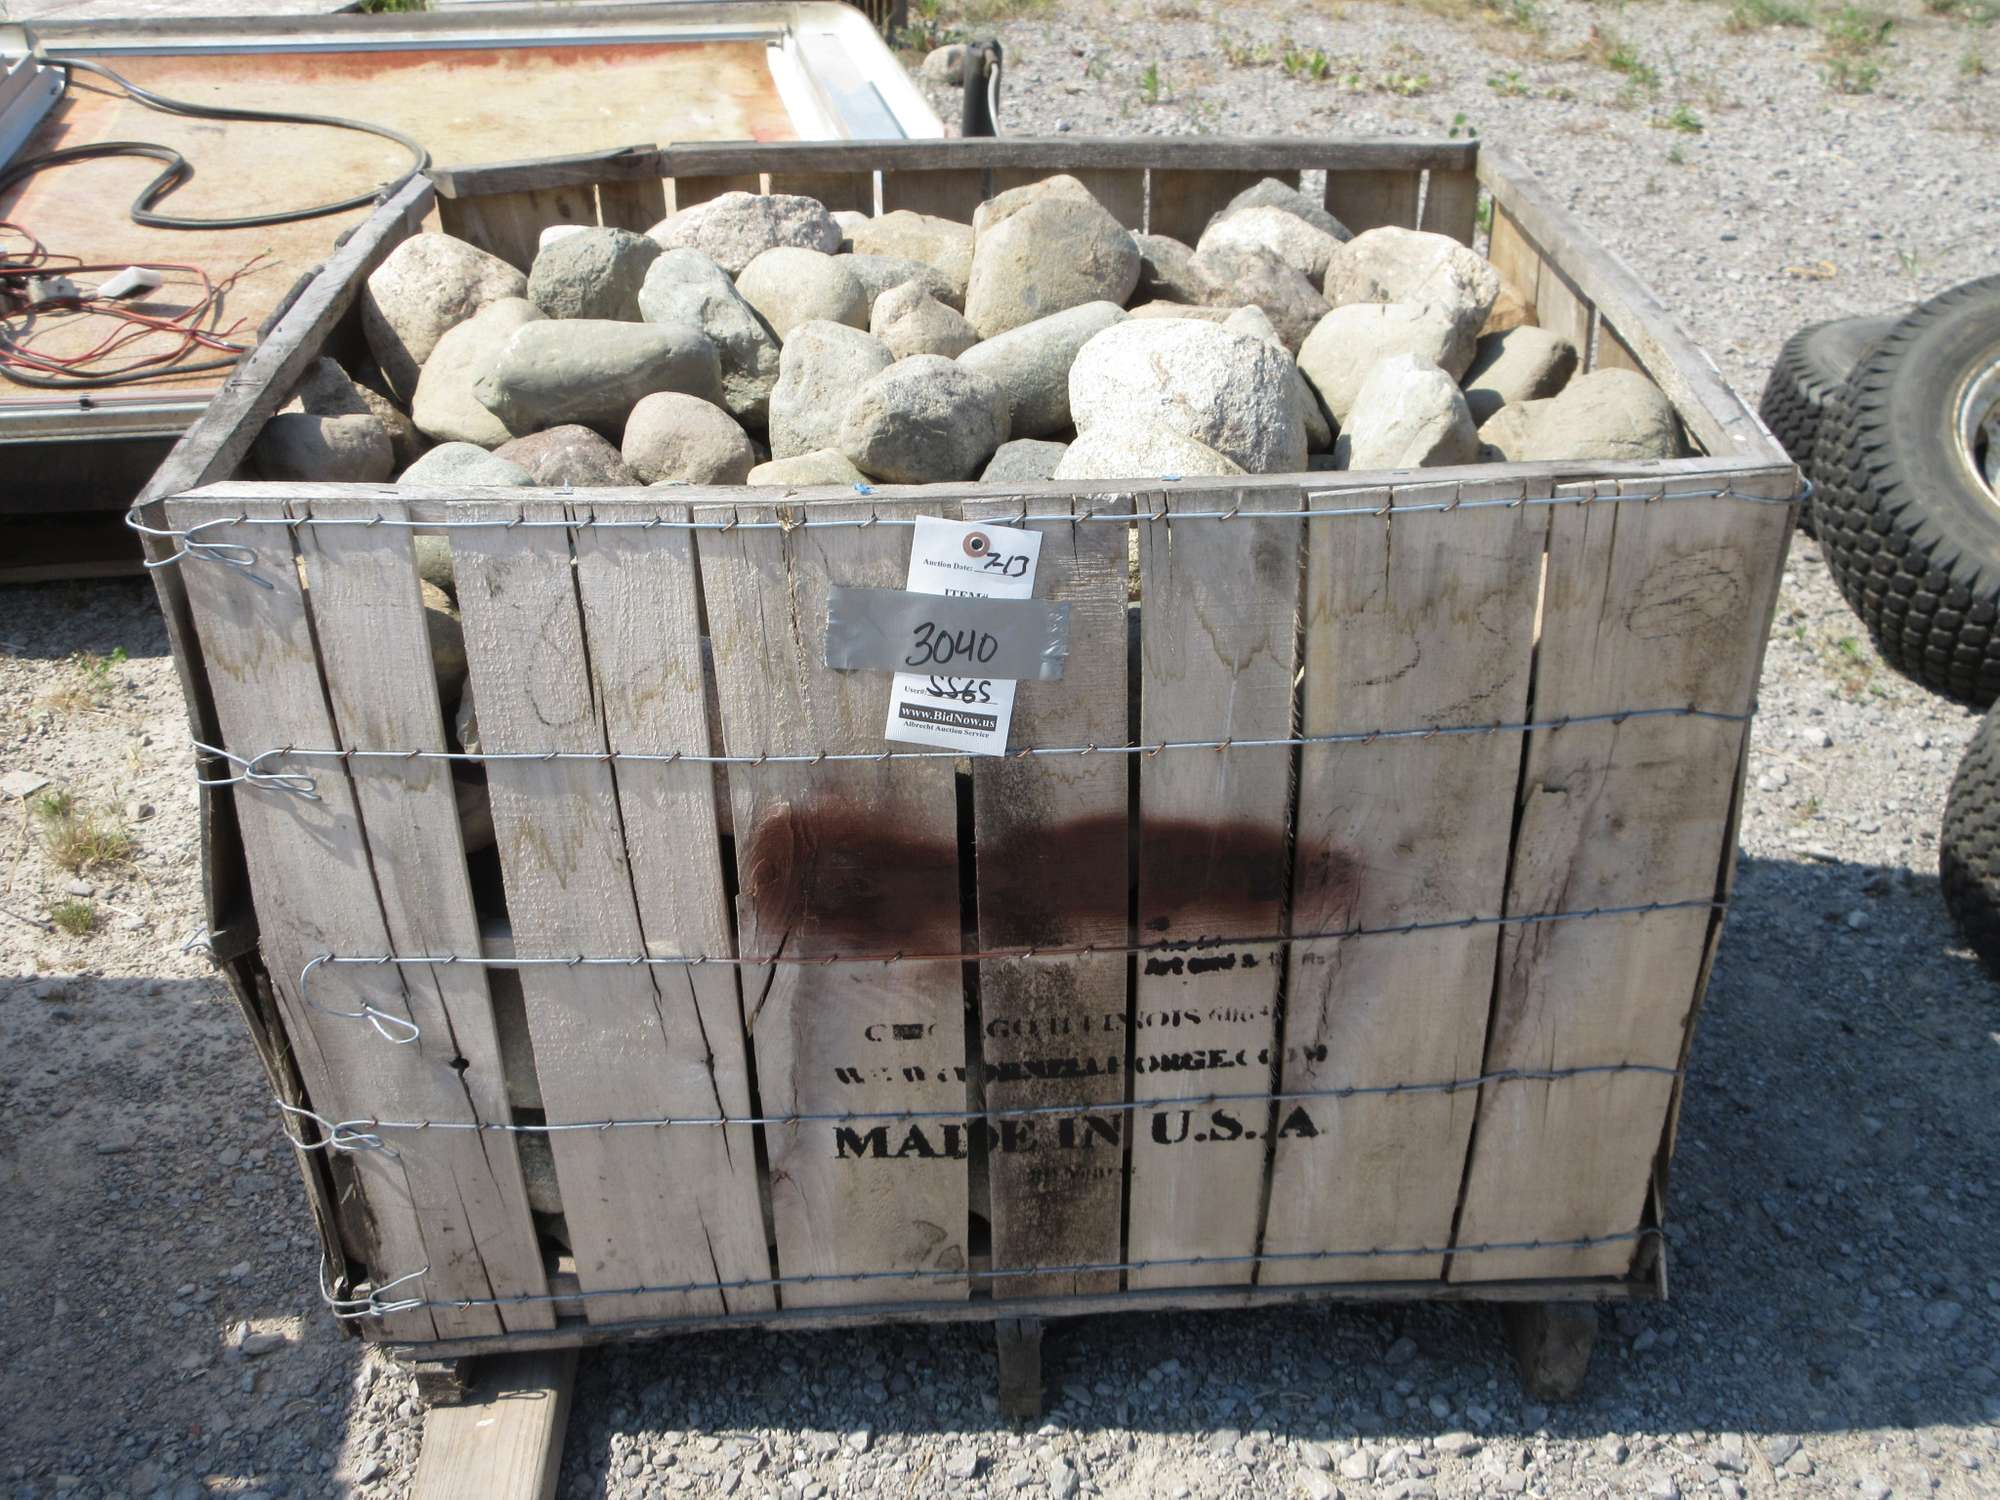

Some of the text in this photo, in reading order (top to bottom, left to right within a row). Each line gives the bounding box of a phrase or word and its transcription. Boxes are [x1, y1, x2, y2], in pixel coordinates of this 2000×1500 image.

[923, 552, 1030, 578] Auction Date: 7-13
[905, 621, 999, 666] 3040
[904, 685, 927, 697] User#:
[900, 705, 996, 729] www.BidNow.us
[903, 720, 990, 739] Albrecht Auction Service
[833, 1116, 1037, 1158] MADE
[1058, 1112, 1122, 1150] IN
